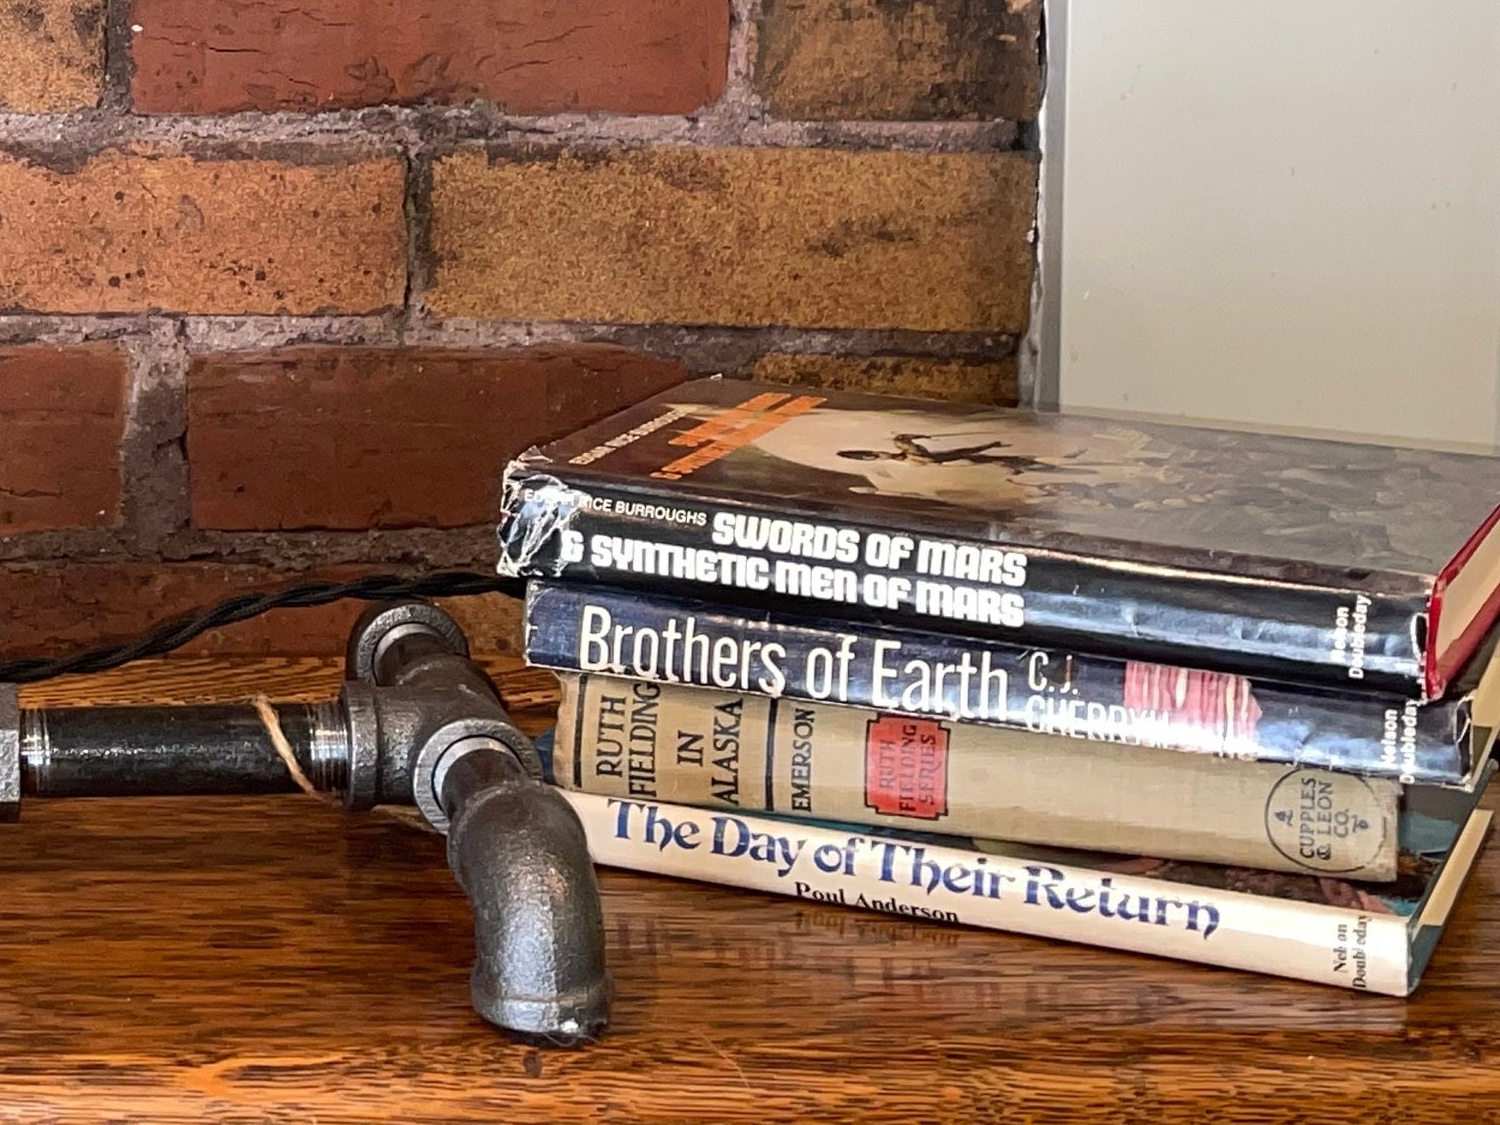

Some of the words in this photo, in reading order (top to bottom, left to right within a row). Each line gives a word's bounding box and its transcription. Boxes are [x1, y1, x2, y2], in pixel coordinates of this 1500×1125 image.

[614, 500, 708, 526] BURROUGHS
[711, 511, 861, 564] SWORDS
[865, 532, 915, 570] OF
[916, 539, 1028, 587] MARS
[560, 529, 585, 563] &
[590, 533, 770, 591] SYNTHETIC
[774, 559, 858, 603] MEN
[862, 573, 912, 610] OF
[915, 579, 1026, 627] MARS
[579, 605, 787, 698] Brothers
[805, 634, 858, 702] of
[872, 639, 1009, 722] Earth
[1028, 651, 1054, 692] C.
[1060, 654, 1079, 695] J.
[1349, 593, 1372, 679] Doubleday
[596, 695, 627, 778] RUTH
[628, 682, 661, 798] FIELDING
[677, 730, 704, 767] IN
[711, 697, 743, 806] ALASKA
[791, 708, 815, 812] EMERSON
[1025, 694, 1170, 749] CHERRYH
[1381, 709, 1398, 767] Nelson
[1400, 699, 1424, 784] Doubleday
[879, 739, 897, 789] RUTH
[899, 724, 917, 812] FIELDING
[918, 734, 941, 806] SERIES
[1299, 777, 1317, 859] CUPPLES
[1316, 780, 1334, 836] LEON
[1333, 808, 1351, 838] CO.
[607, 799, 701, 852] The
[711, 815, 807, 877] Day
[813, 838, 868, 877] of
[869, 840, 1016, 899] Their
[1022, 865, 1222, 940] Return
[794, 881, 847, 905] Poul
[854, 892, 961, 923] Anderson
